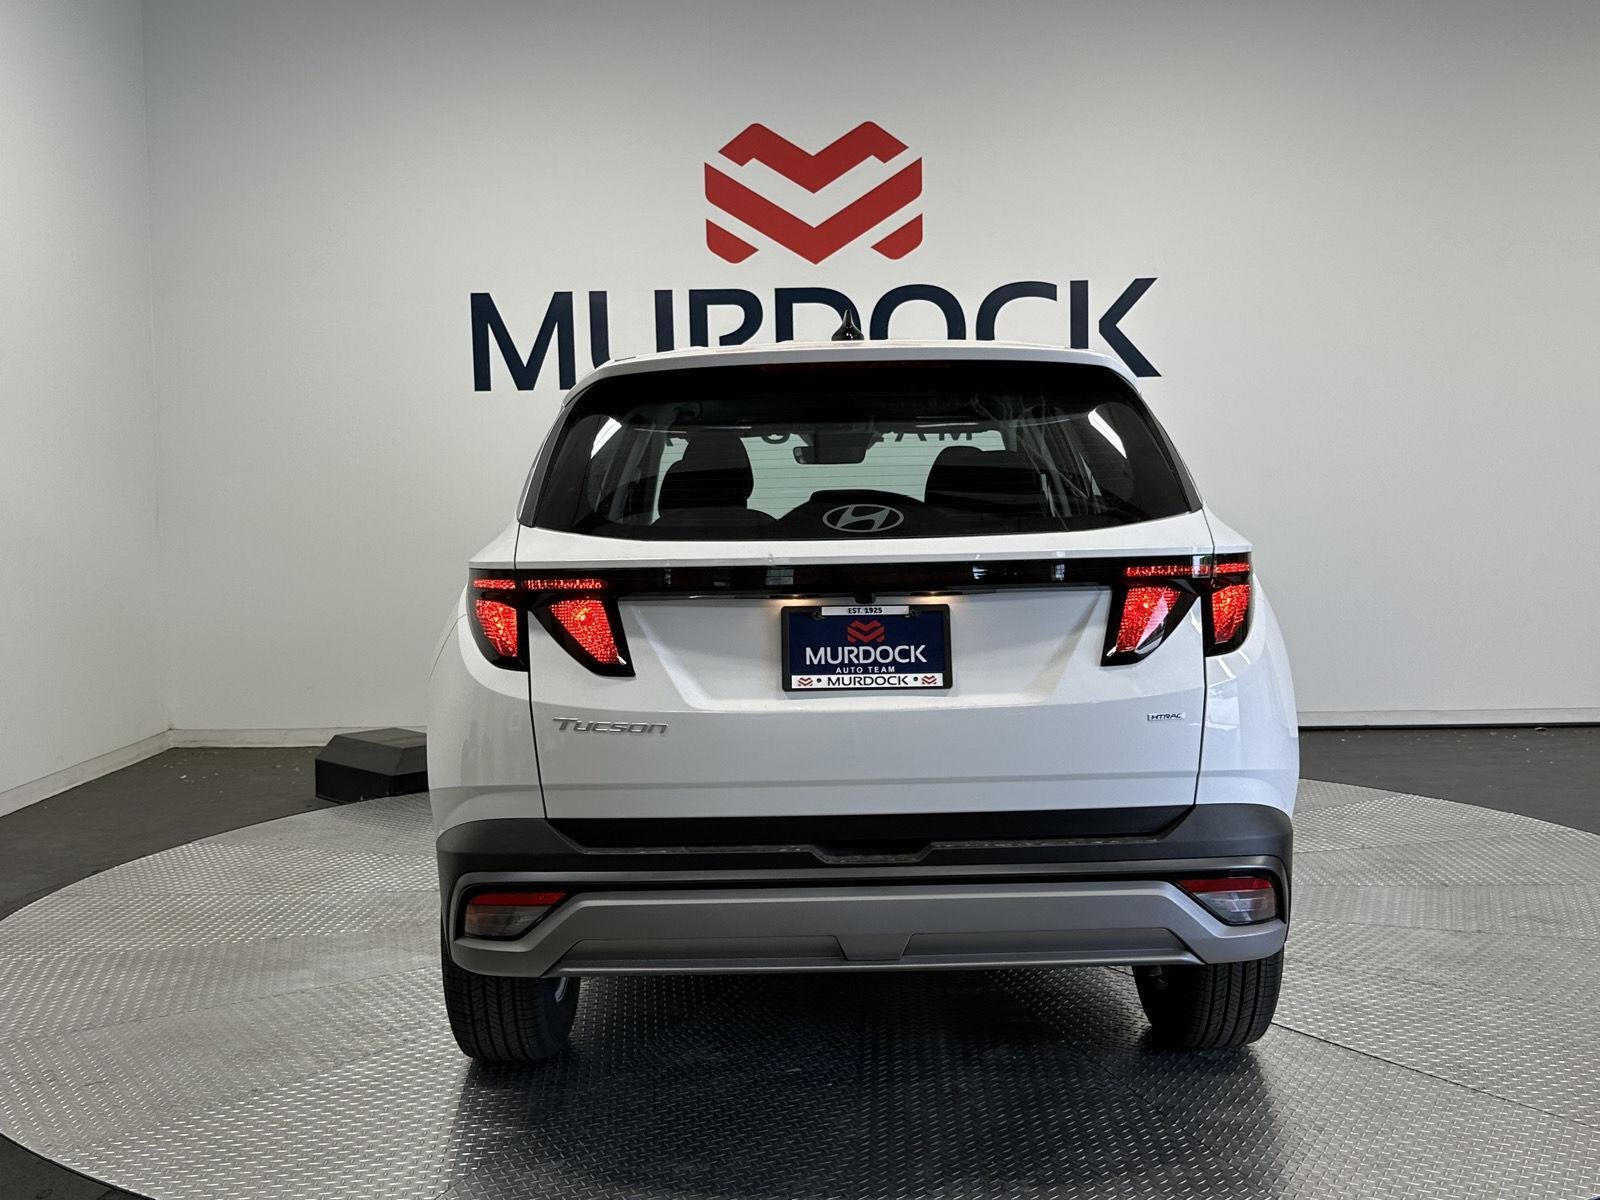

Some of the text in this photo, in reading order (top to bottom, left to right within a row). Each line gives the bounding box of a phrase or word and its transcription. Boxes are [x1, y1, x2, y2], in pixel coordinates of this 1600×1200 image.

[805, 644, 927, 665] MURDOCK
[835, 666, 863, 674] AUTO
[827, 675, 909, 687] MURDOCK
